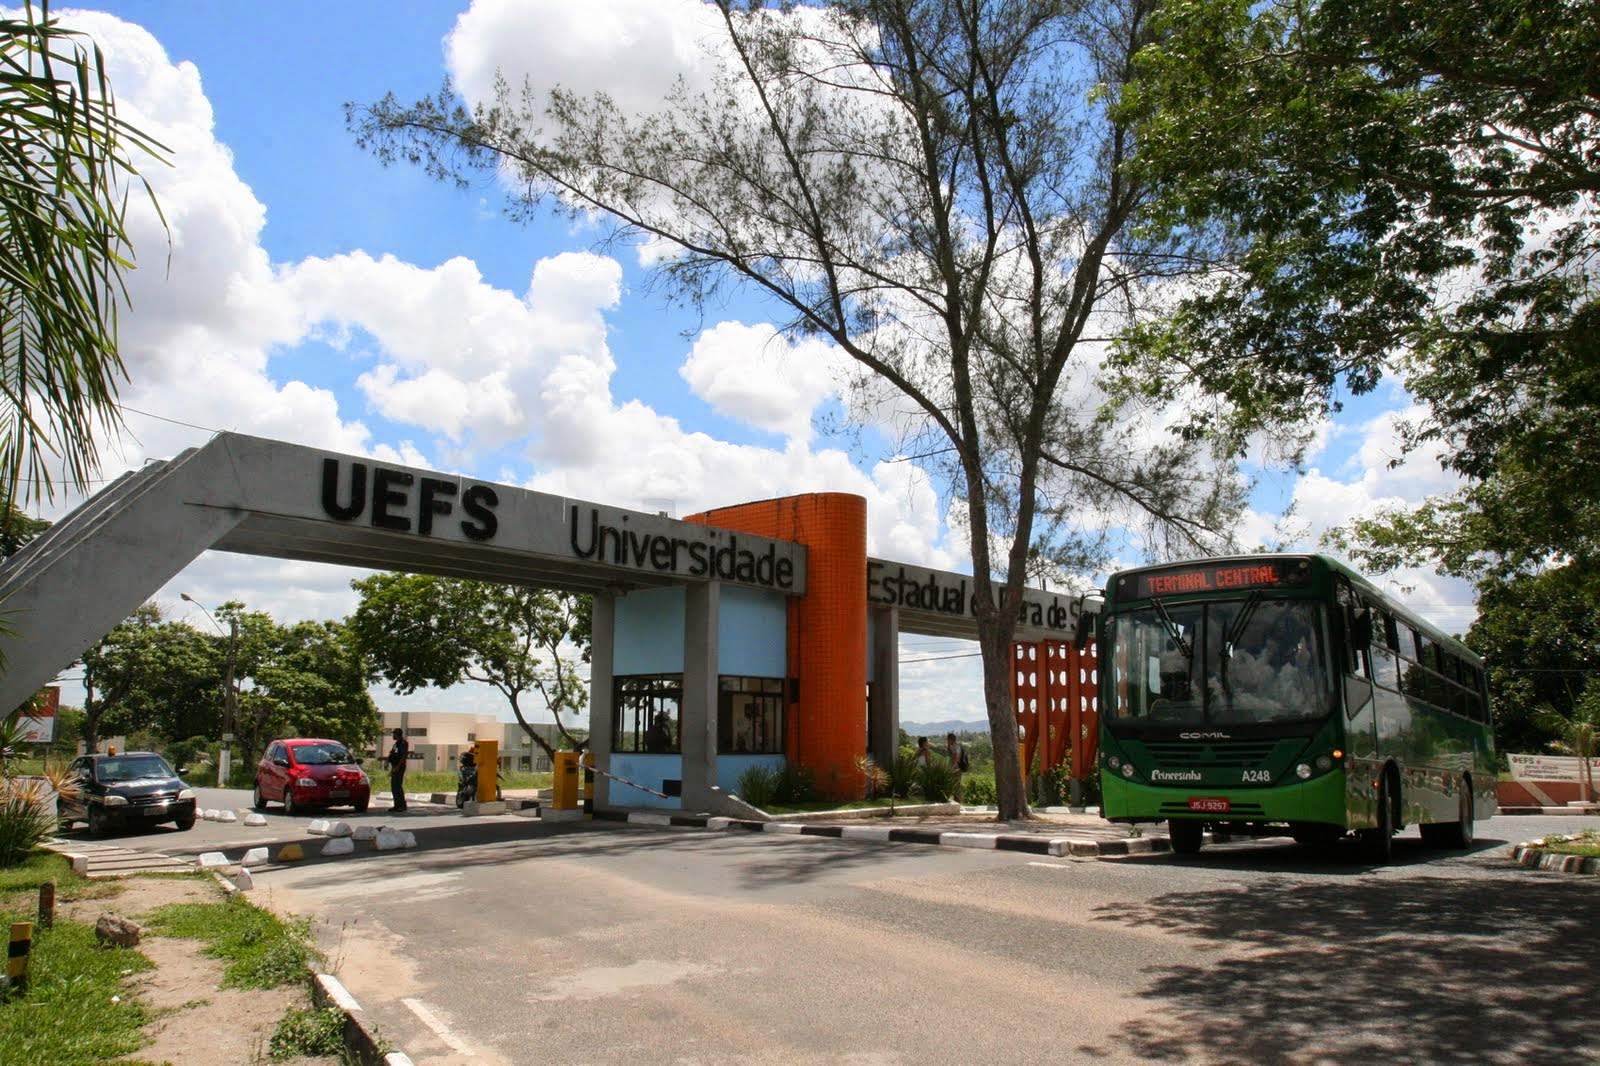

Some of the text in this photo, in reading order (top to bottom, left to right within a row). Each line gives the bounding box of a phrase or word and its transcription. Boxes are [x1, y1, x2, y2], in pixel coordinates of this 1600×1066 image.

[321, 458, 499, 542] UEFS
[569, 504, 794, 589] Universidade
[867, 562, 966, 616] Estadual
[1047, 596, 1067, 630] de
[1147, 565, 1279, 594] TERMINAL CENTRAL
[1151, 769, 1202, 781] Princesinha
[1242, 770, 1271, 782] A248
